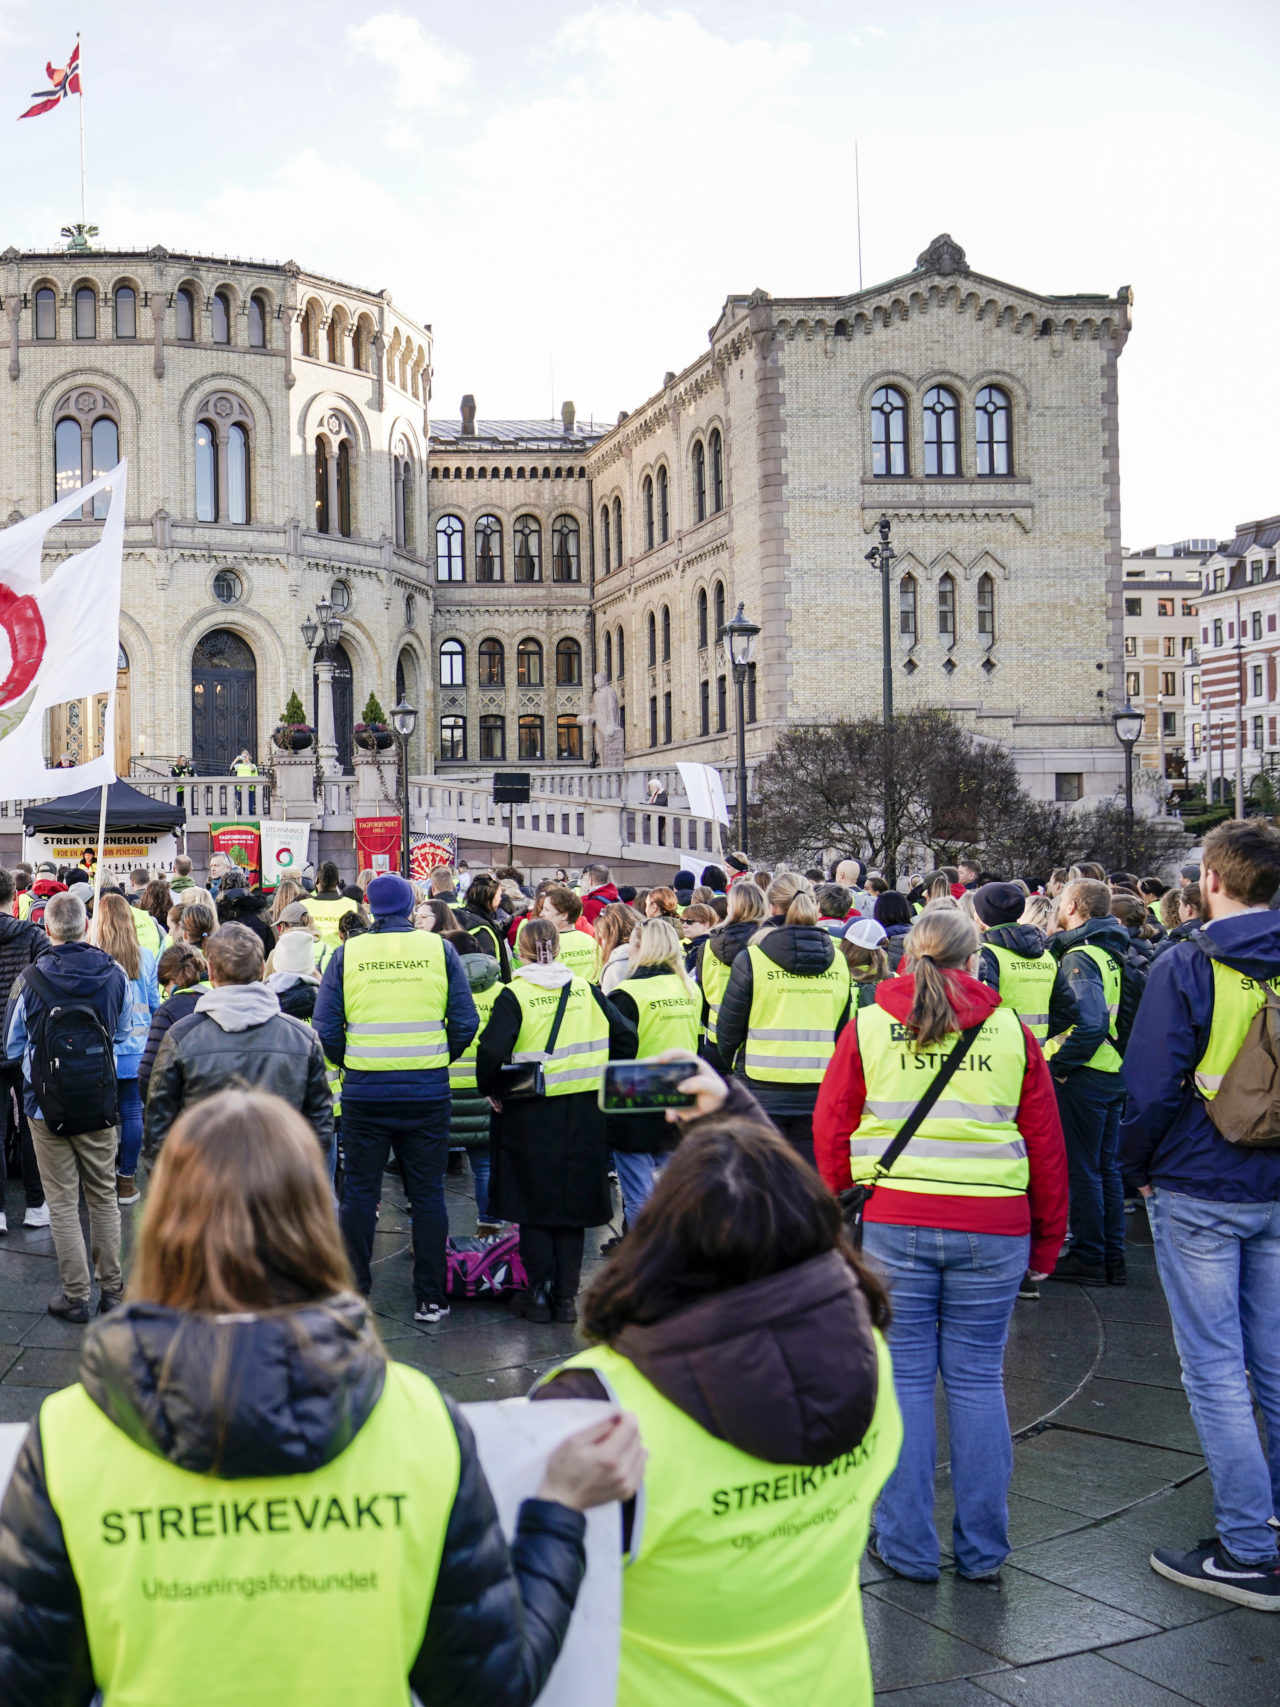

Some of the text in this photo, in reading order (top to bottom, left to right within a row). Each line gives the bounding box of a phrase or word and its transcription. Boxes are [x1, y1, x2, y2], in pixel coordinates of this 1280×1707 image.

[43, 837, 80, 845] STREIK
[83, 837, 86, 845] I
[560, 949, 593, 960] STREIKEVA
[358, 959, 430, 971] STREIKEVAKT
[529, 989, 586, 1008] STREIAKT
[901, 1053, 906, 1070] I
[101, 1492, 408, 1546] STREIKEVAKT
[140, 1569, 379, 1601] Utdanningsforbundet
